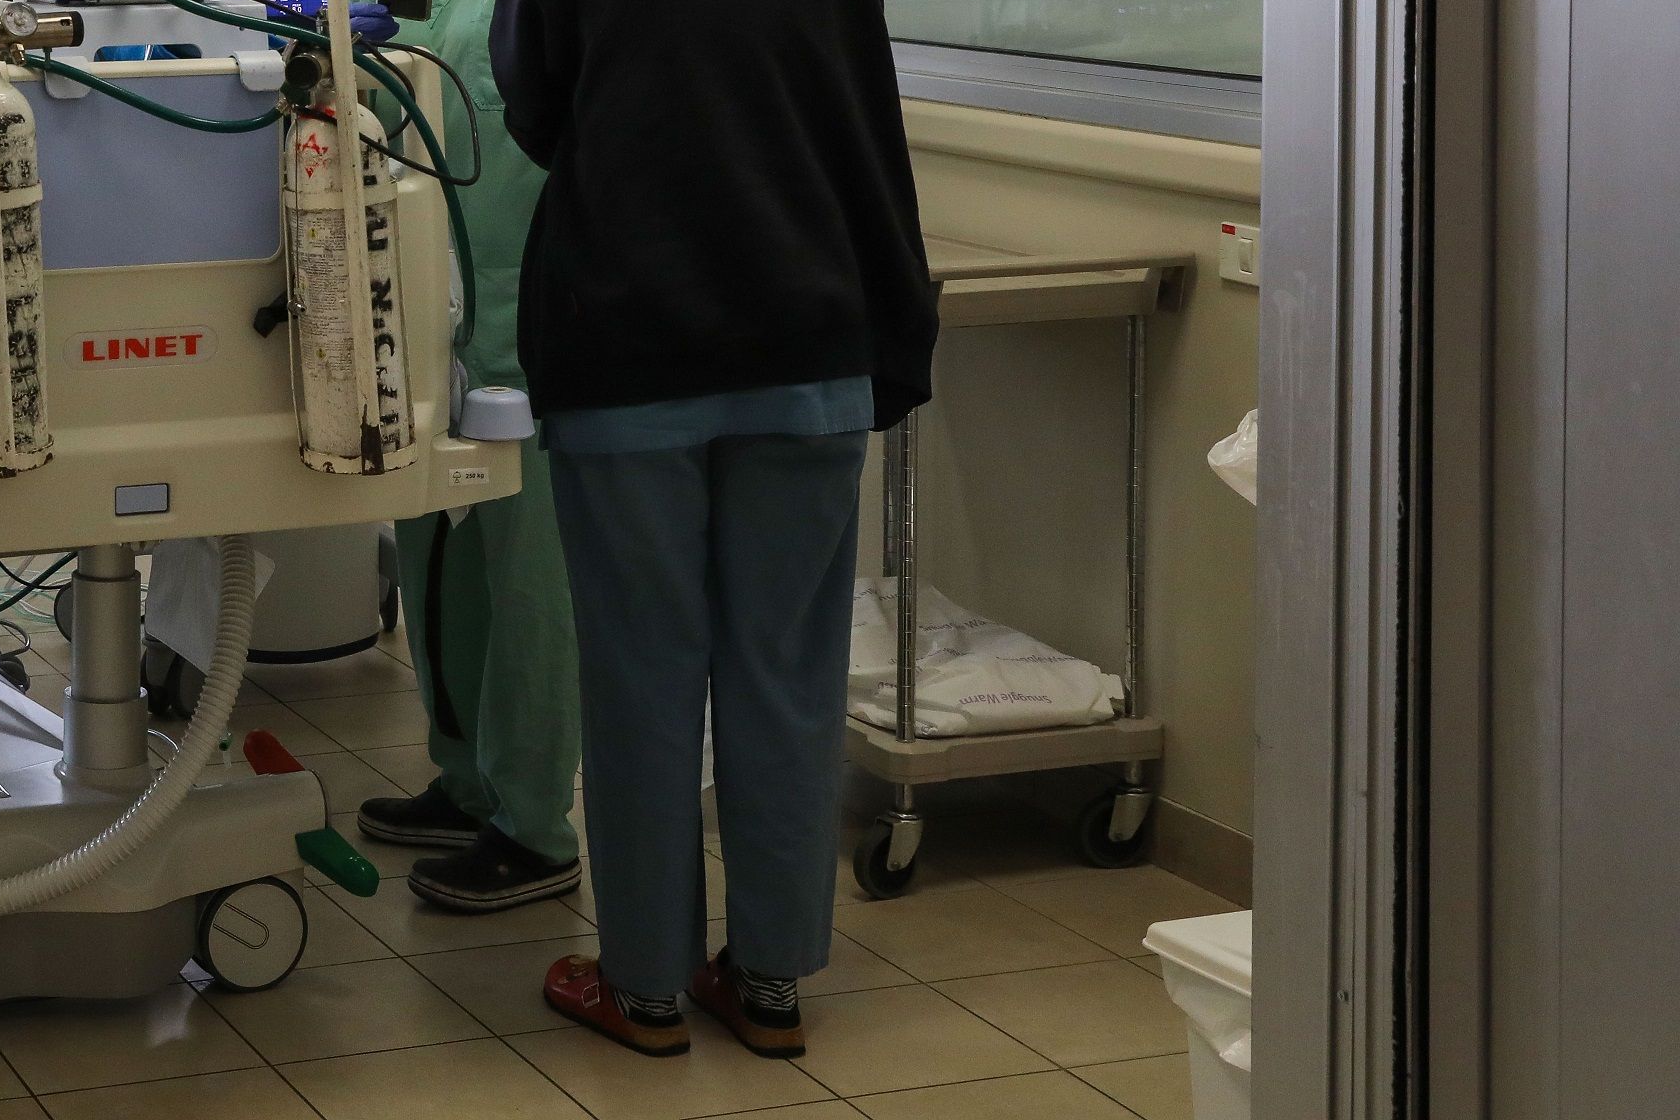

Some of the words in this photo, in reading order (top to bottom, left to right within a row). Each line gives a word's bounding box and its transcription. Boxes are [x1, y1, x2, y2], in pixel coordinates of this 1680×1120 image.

[82, 334, 203, 362] LINET
[958, 693, 1001, 705] Warm
[1001, 692, 1053, 704] Snuggle
